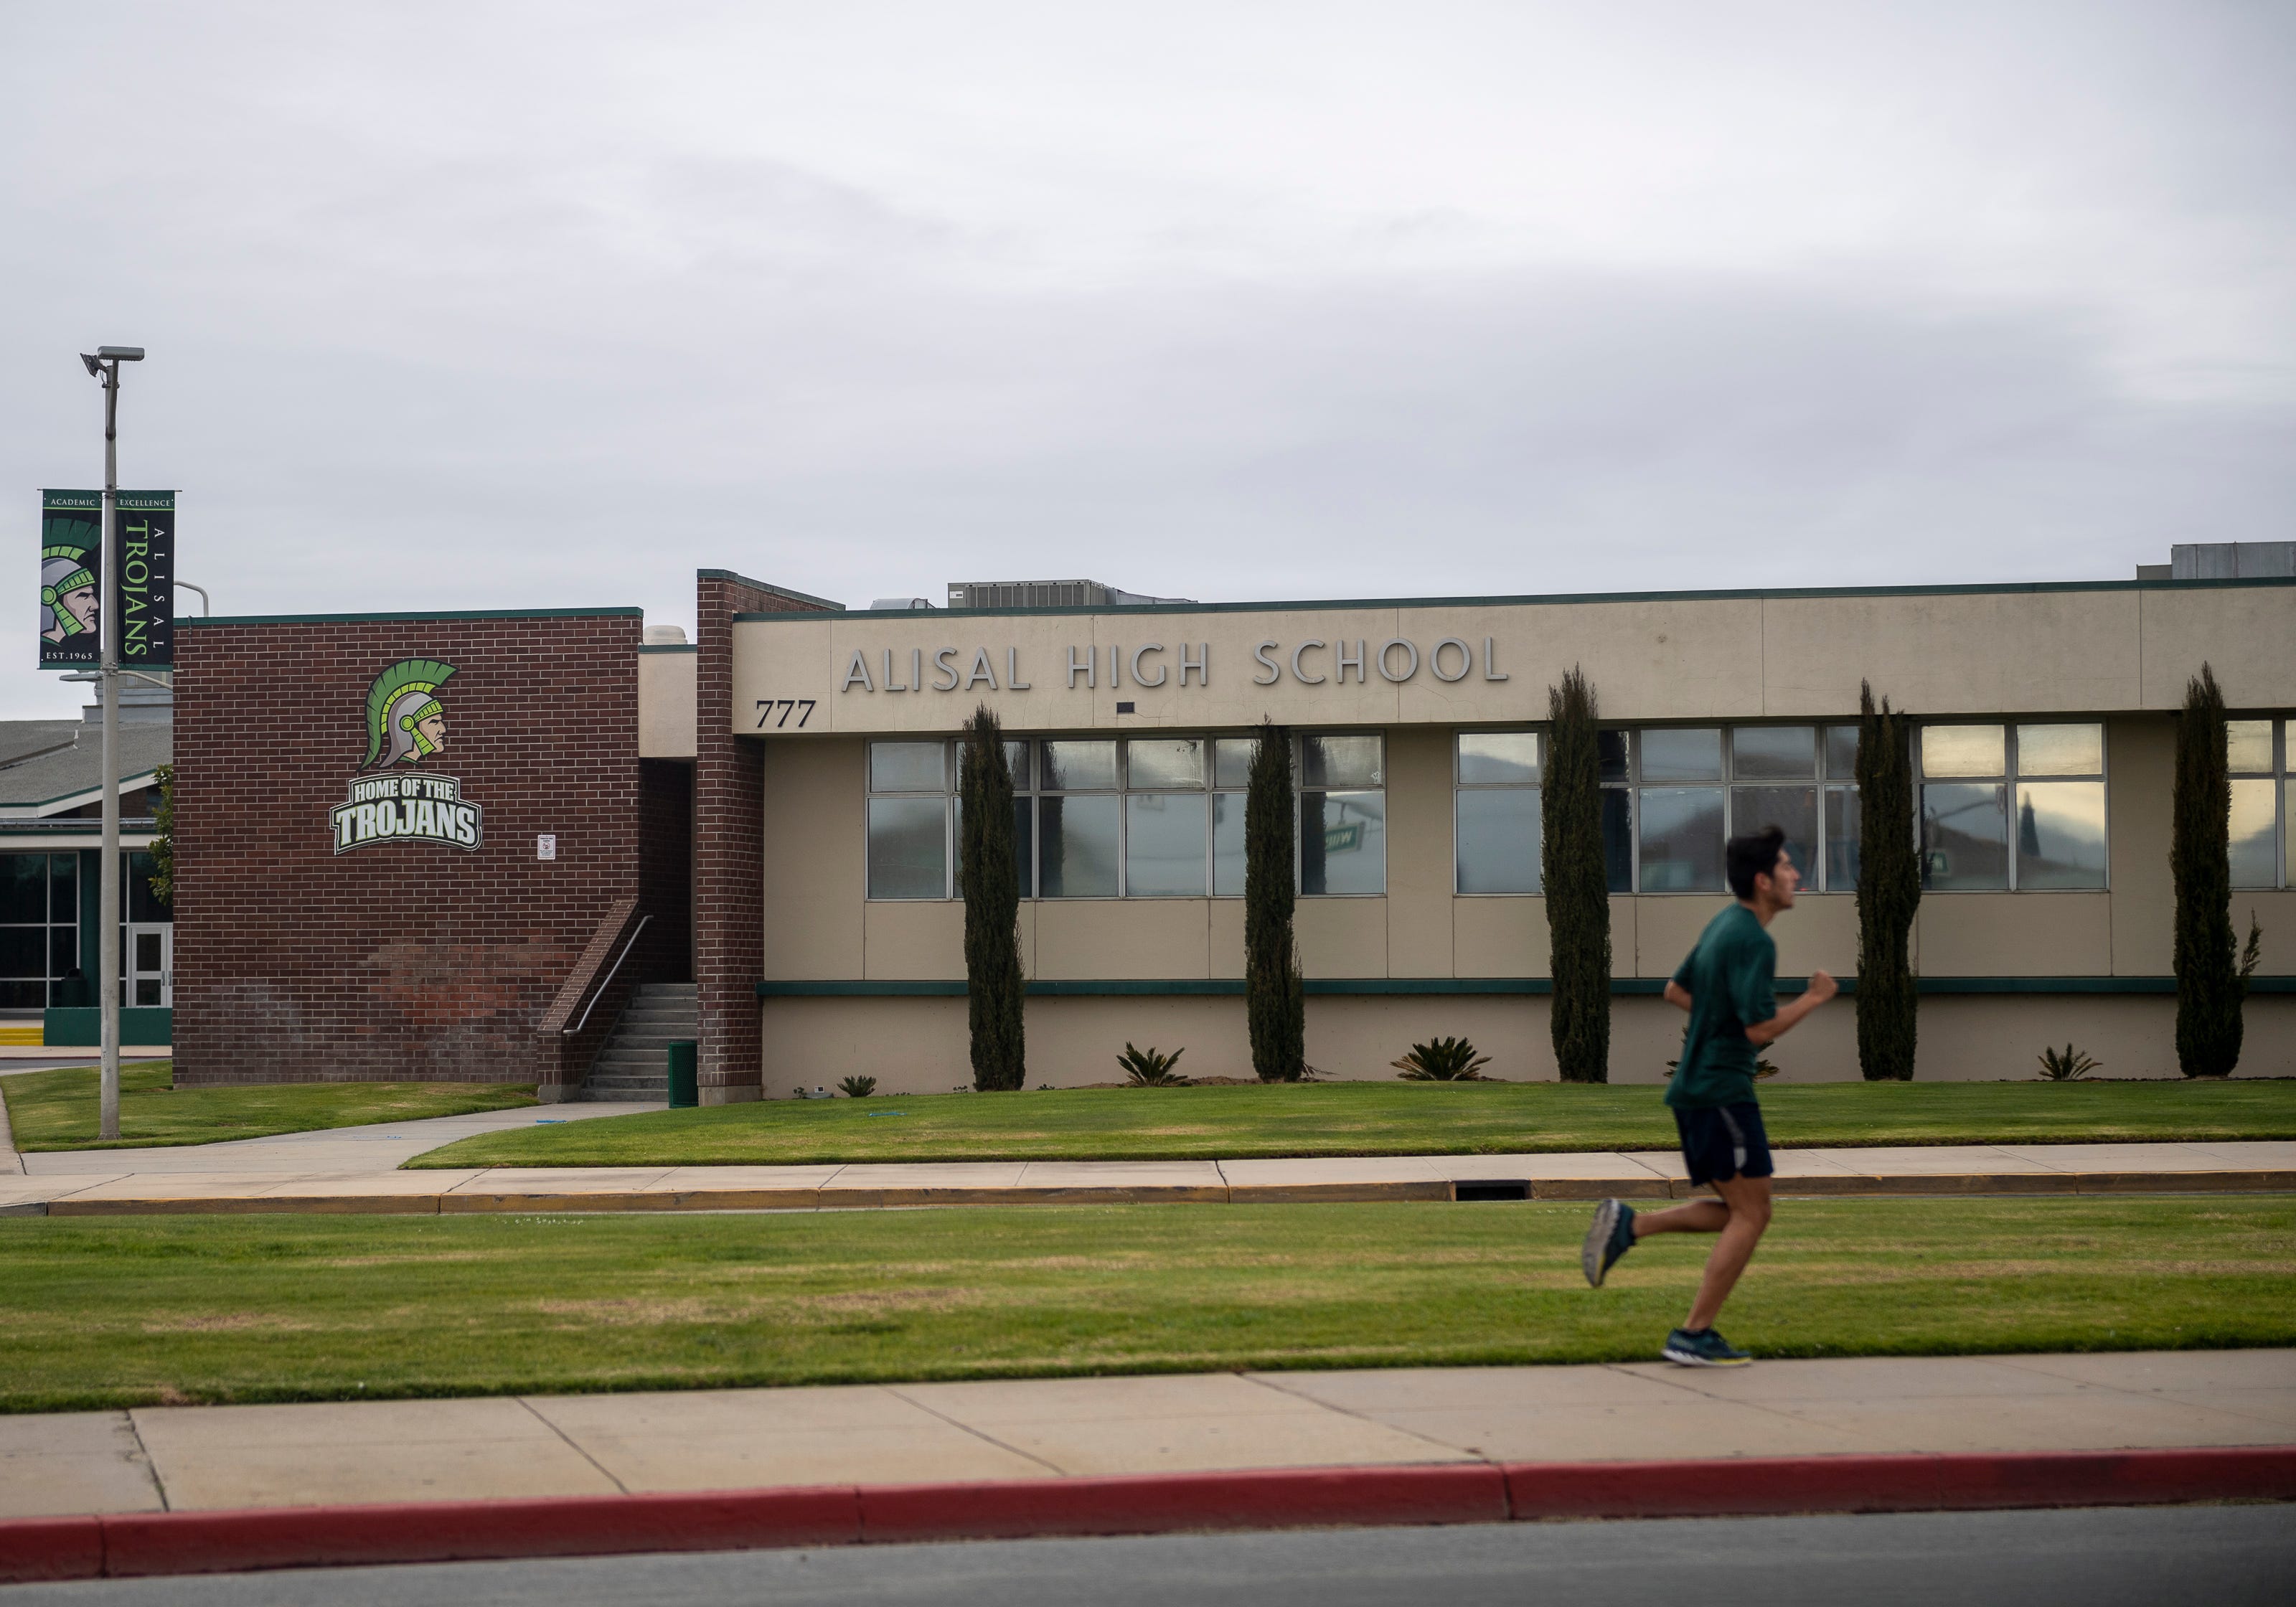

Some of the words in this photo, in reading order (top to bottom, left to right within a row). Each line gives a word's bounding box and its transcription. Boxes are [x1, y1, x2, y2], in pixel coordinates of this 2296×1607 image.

[121, 519, 149, 655] TROJANS
[153, 528, 165, 648] ALISAL
[842, 646, 1030, 692] ALISAL
[1068, 642, 1208, 689] HIGH
[1253, 636, 1508, 685] SCHOOL
[756, 700, 817, 728] 777
[354, 781, 398, 803] HOME
[402, 778, 420, 797] OF
[423, 779, 455, 801] THE
[336, 799, 475, 846] TROJANS
